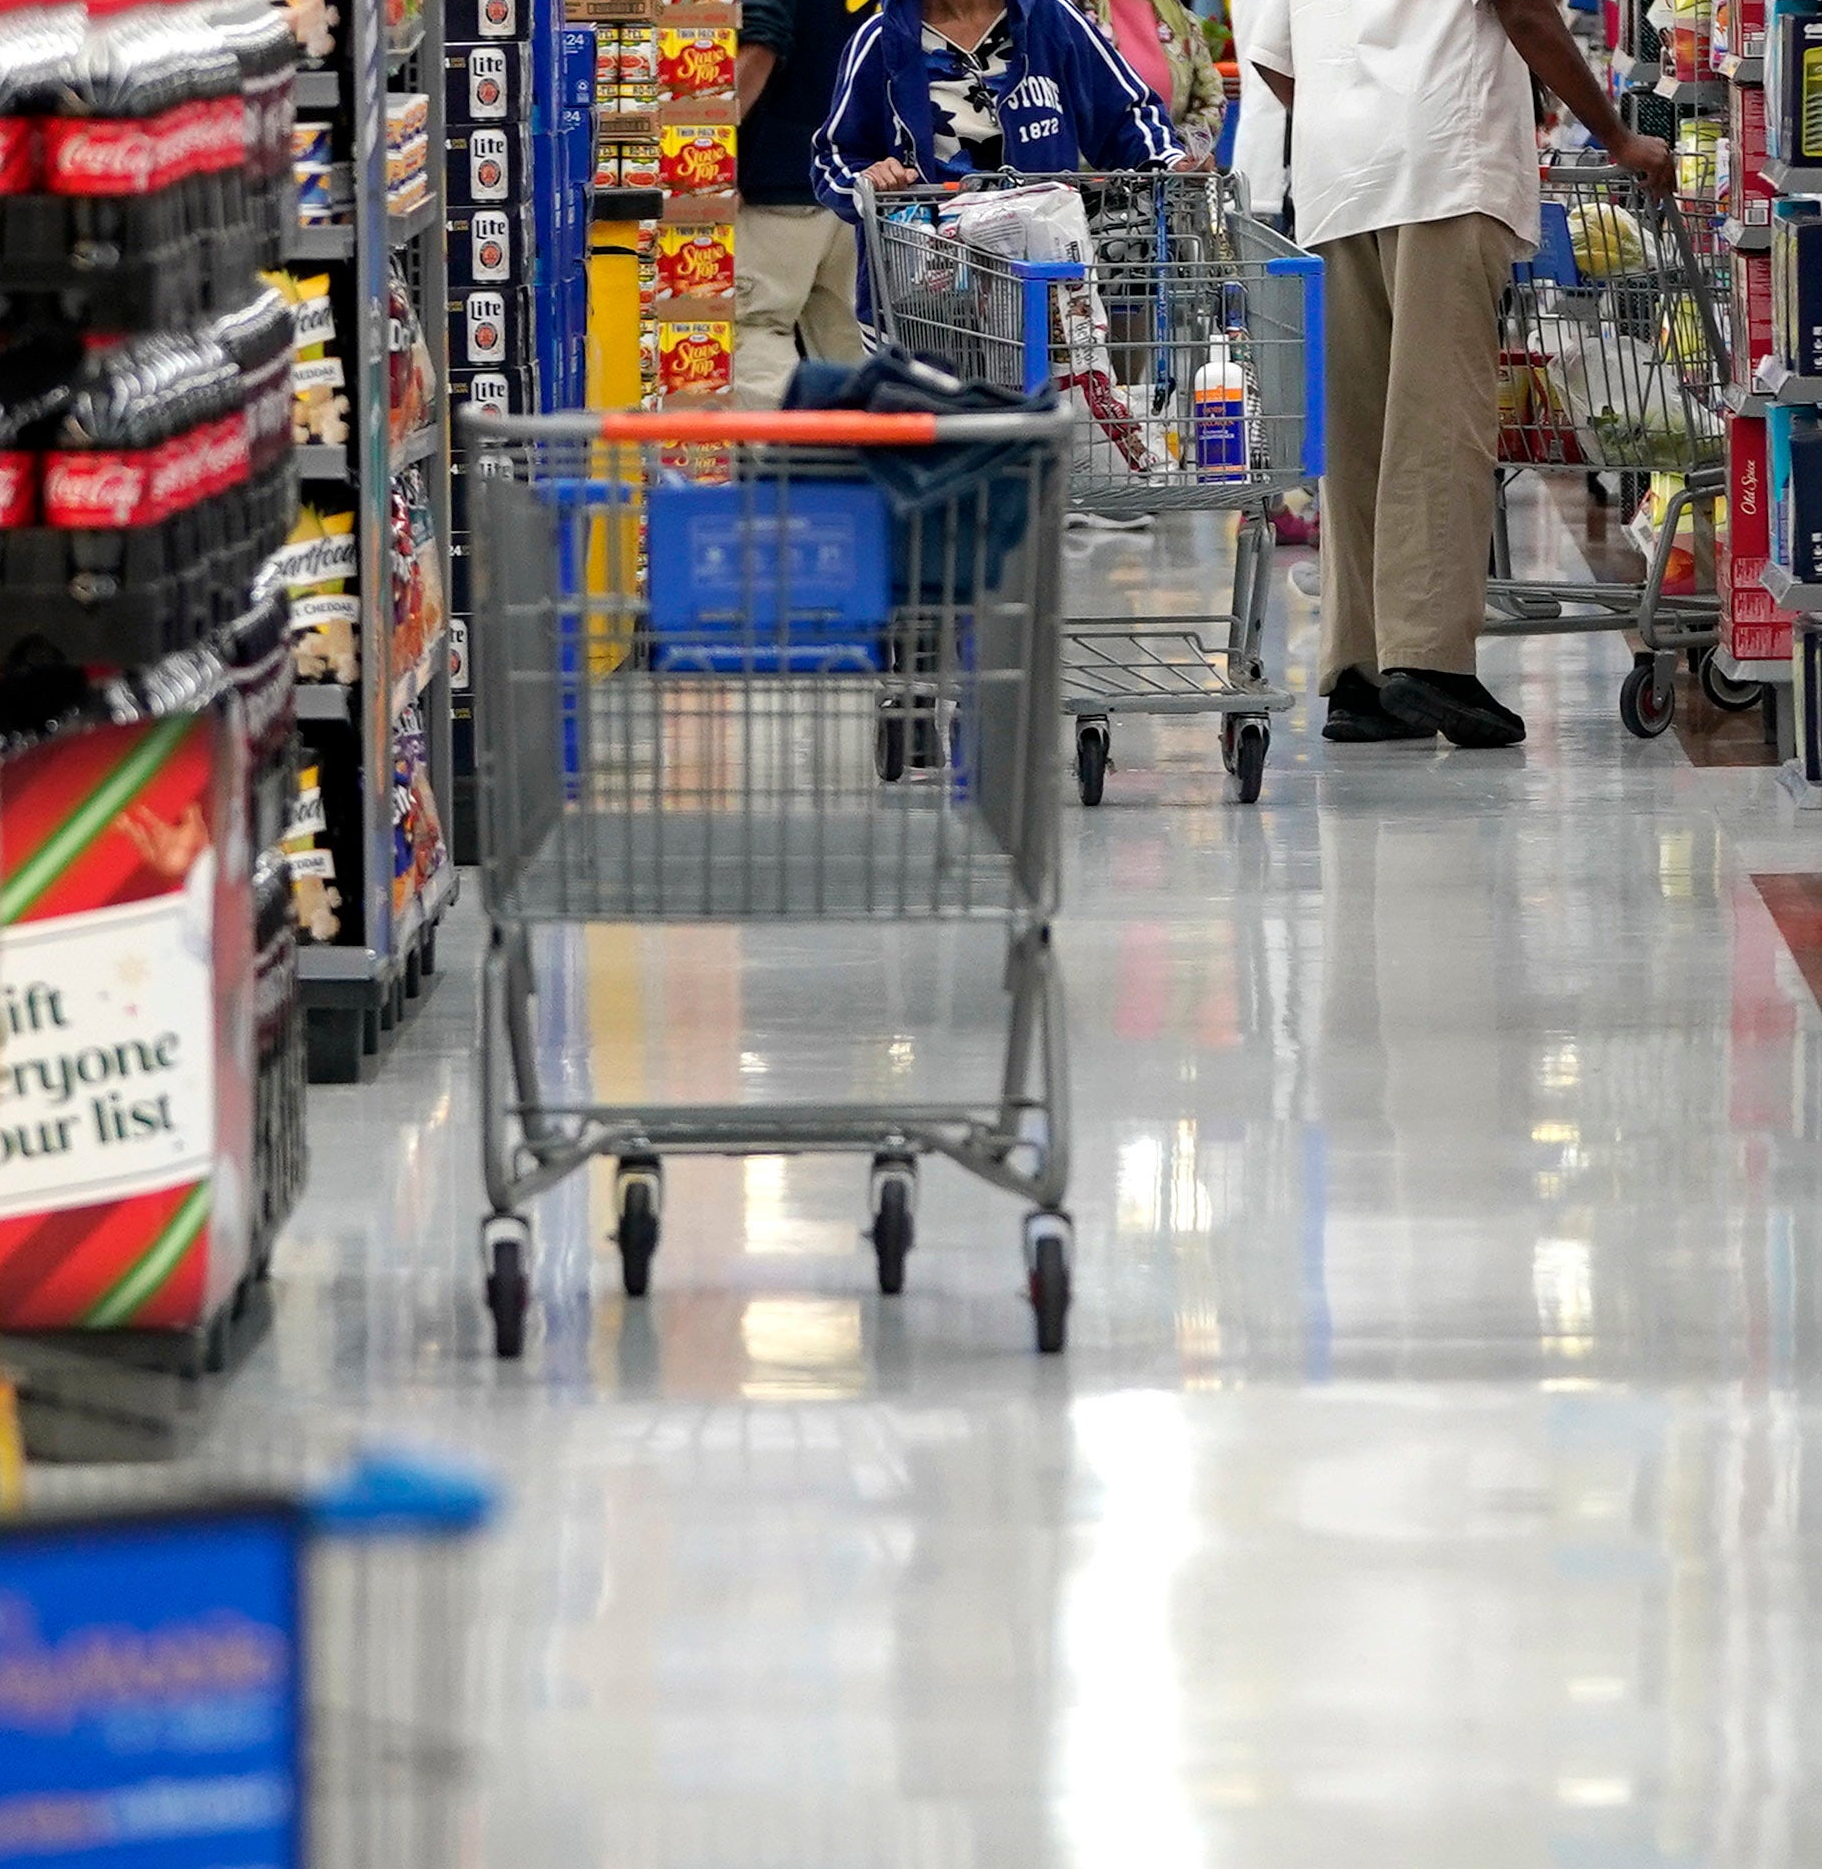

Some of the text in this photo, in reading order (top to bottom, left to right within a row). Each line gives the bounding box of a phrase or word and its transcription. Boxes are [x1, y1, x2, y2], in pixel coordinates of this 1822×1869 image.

[472, 57, 502, 77] Lite
[1019, 118, 1059, 143] 1872
[474, 139, 504, 158] Lite
[476, 220, 506, 240] Lite
[471, 301, 501, 321] Lite
[475, 382, 505, 402] Lite
[92, 1091, 175, 1143] list
